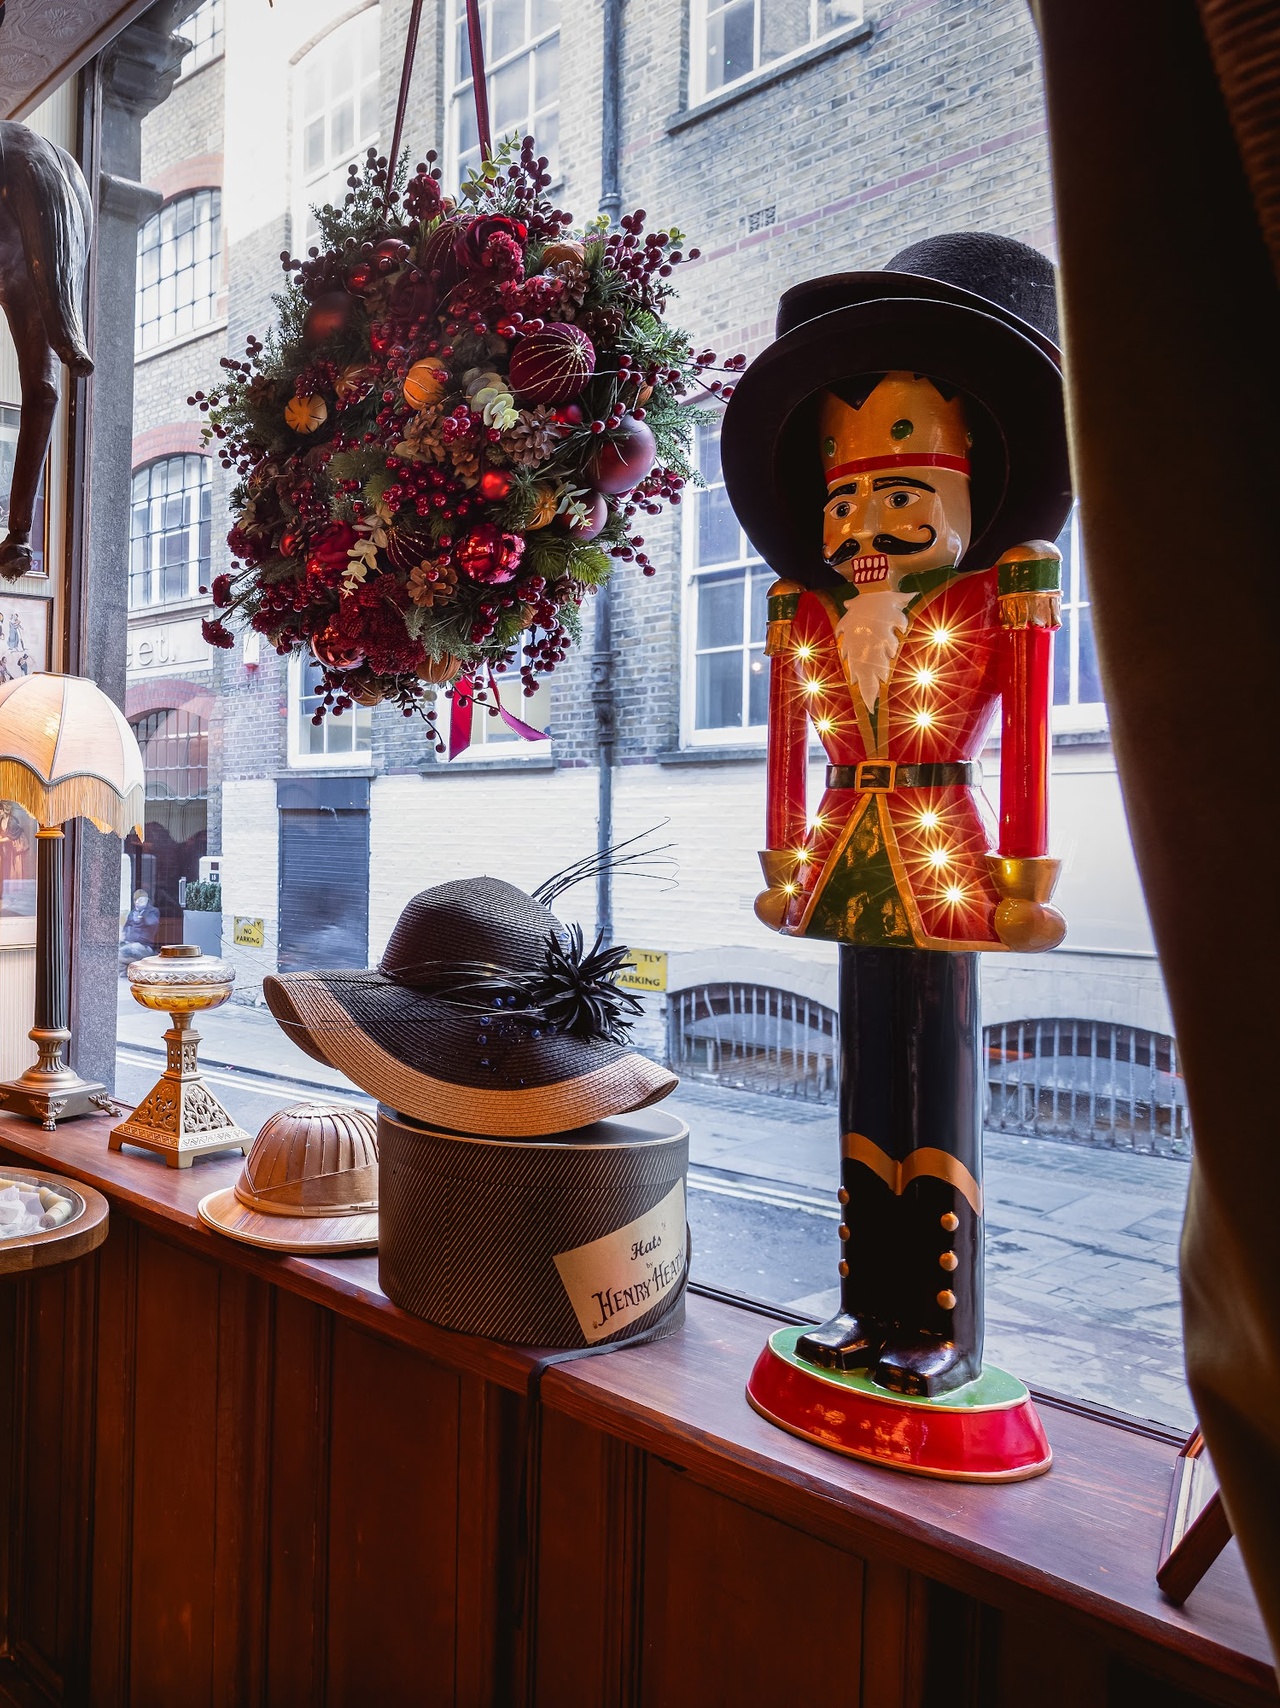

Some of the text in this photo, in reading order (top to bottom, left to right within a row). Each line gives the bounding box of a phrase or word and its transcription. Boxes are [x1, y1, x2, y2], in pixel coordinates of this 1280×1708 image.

[236, 935, 260, 944] PARKING
[631, 1236, 661, 1260] Hats
[591, 1279, 651, 1327] HENRY
